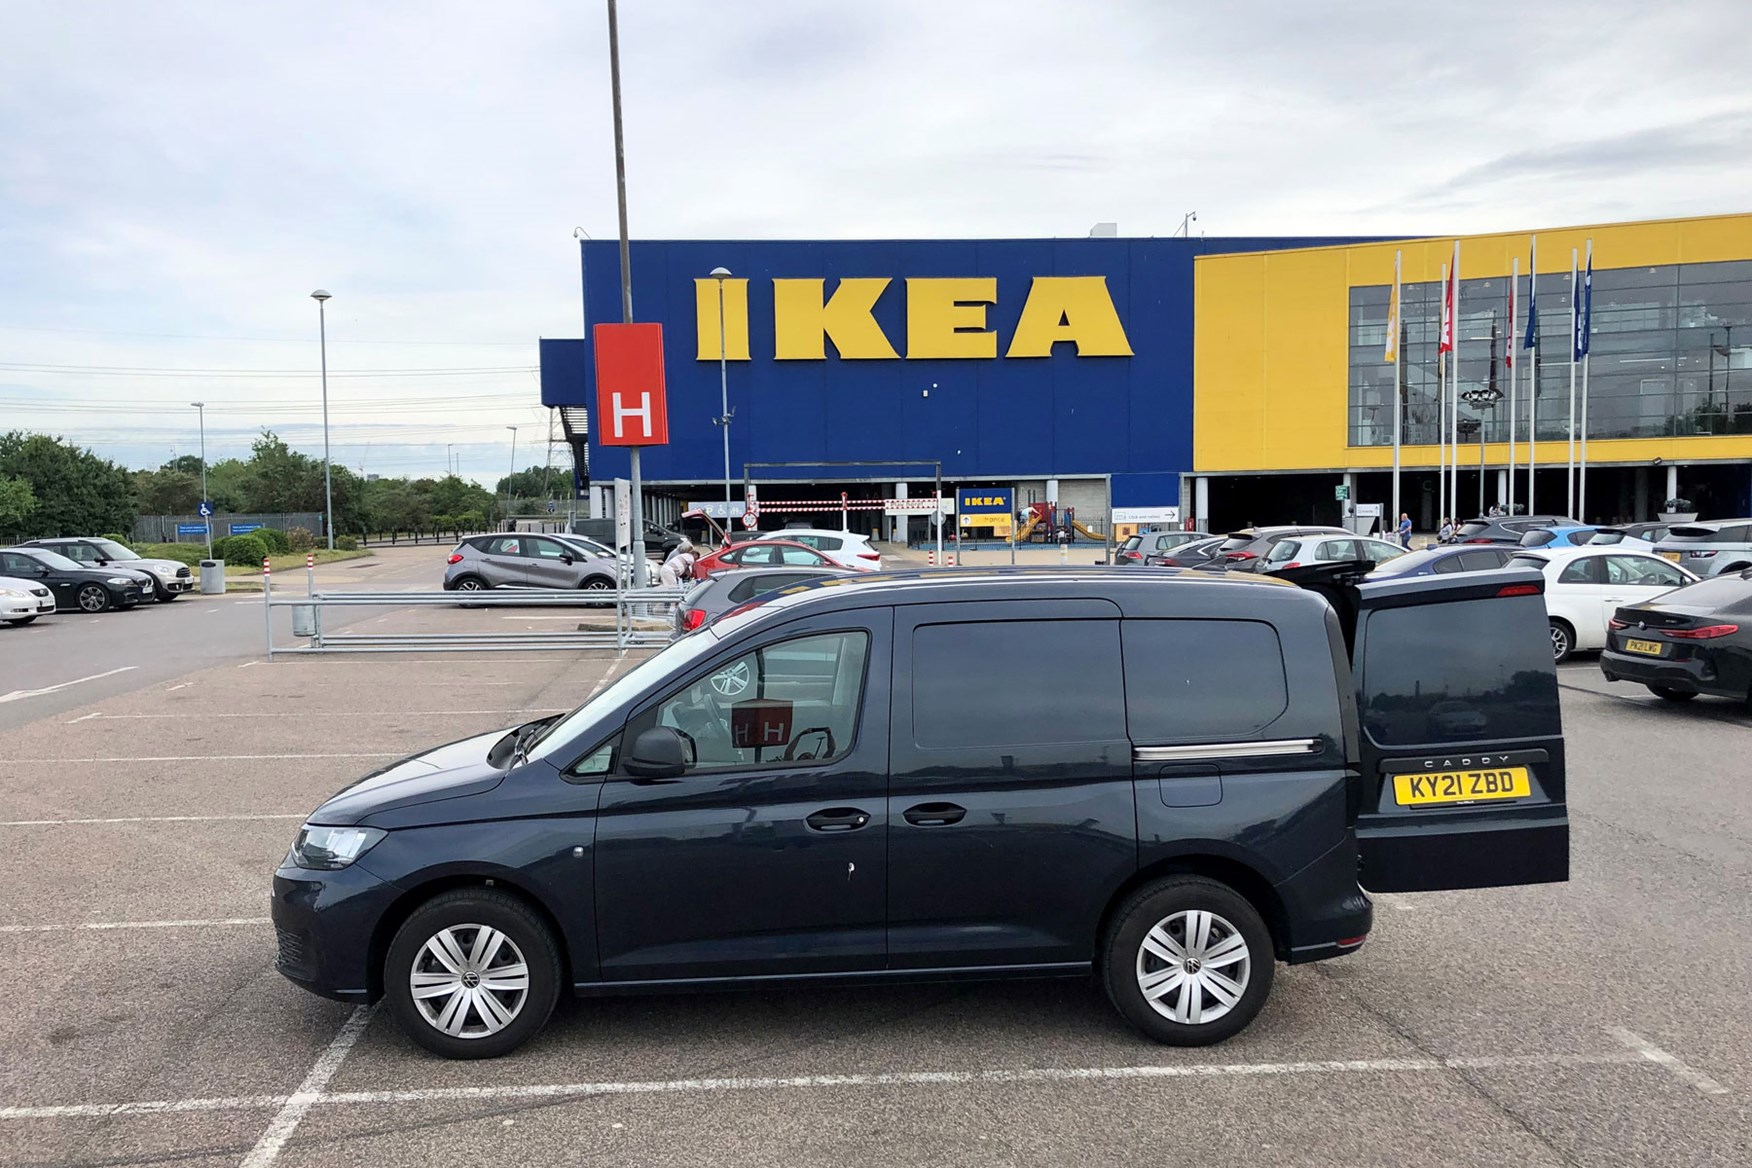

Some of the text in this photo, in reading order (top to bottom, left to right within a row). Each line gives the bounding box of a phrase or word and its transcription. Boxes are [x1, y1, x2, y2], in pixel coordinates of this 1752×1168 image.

[693, 275, 1135, 361] IKEA
[612, 391, 652, 438] H
[964, 496, 1005, 506] IKEA
[1424, 755, 1508, 768] CADDY
[1409, 771, 1514, 798] KY21 ZBD
